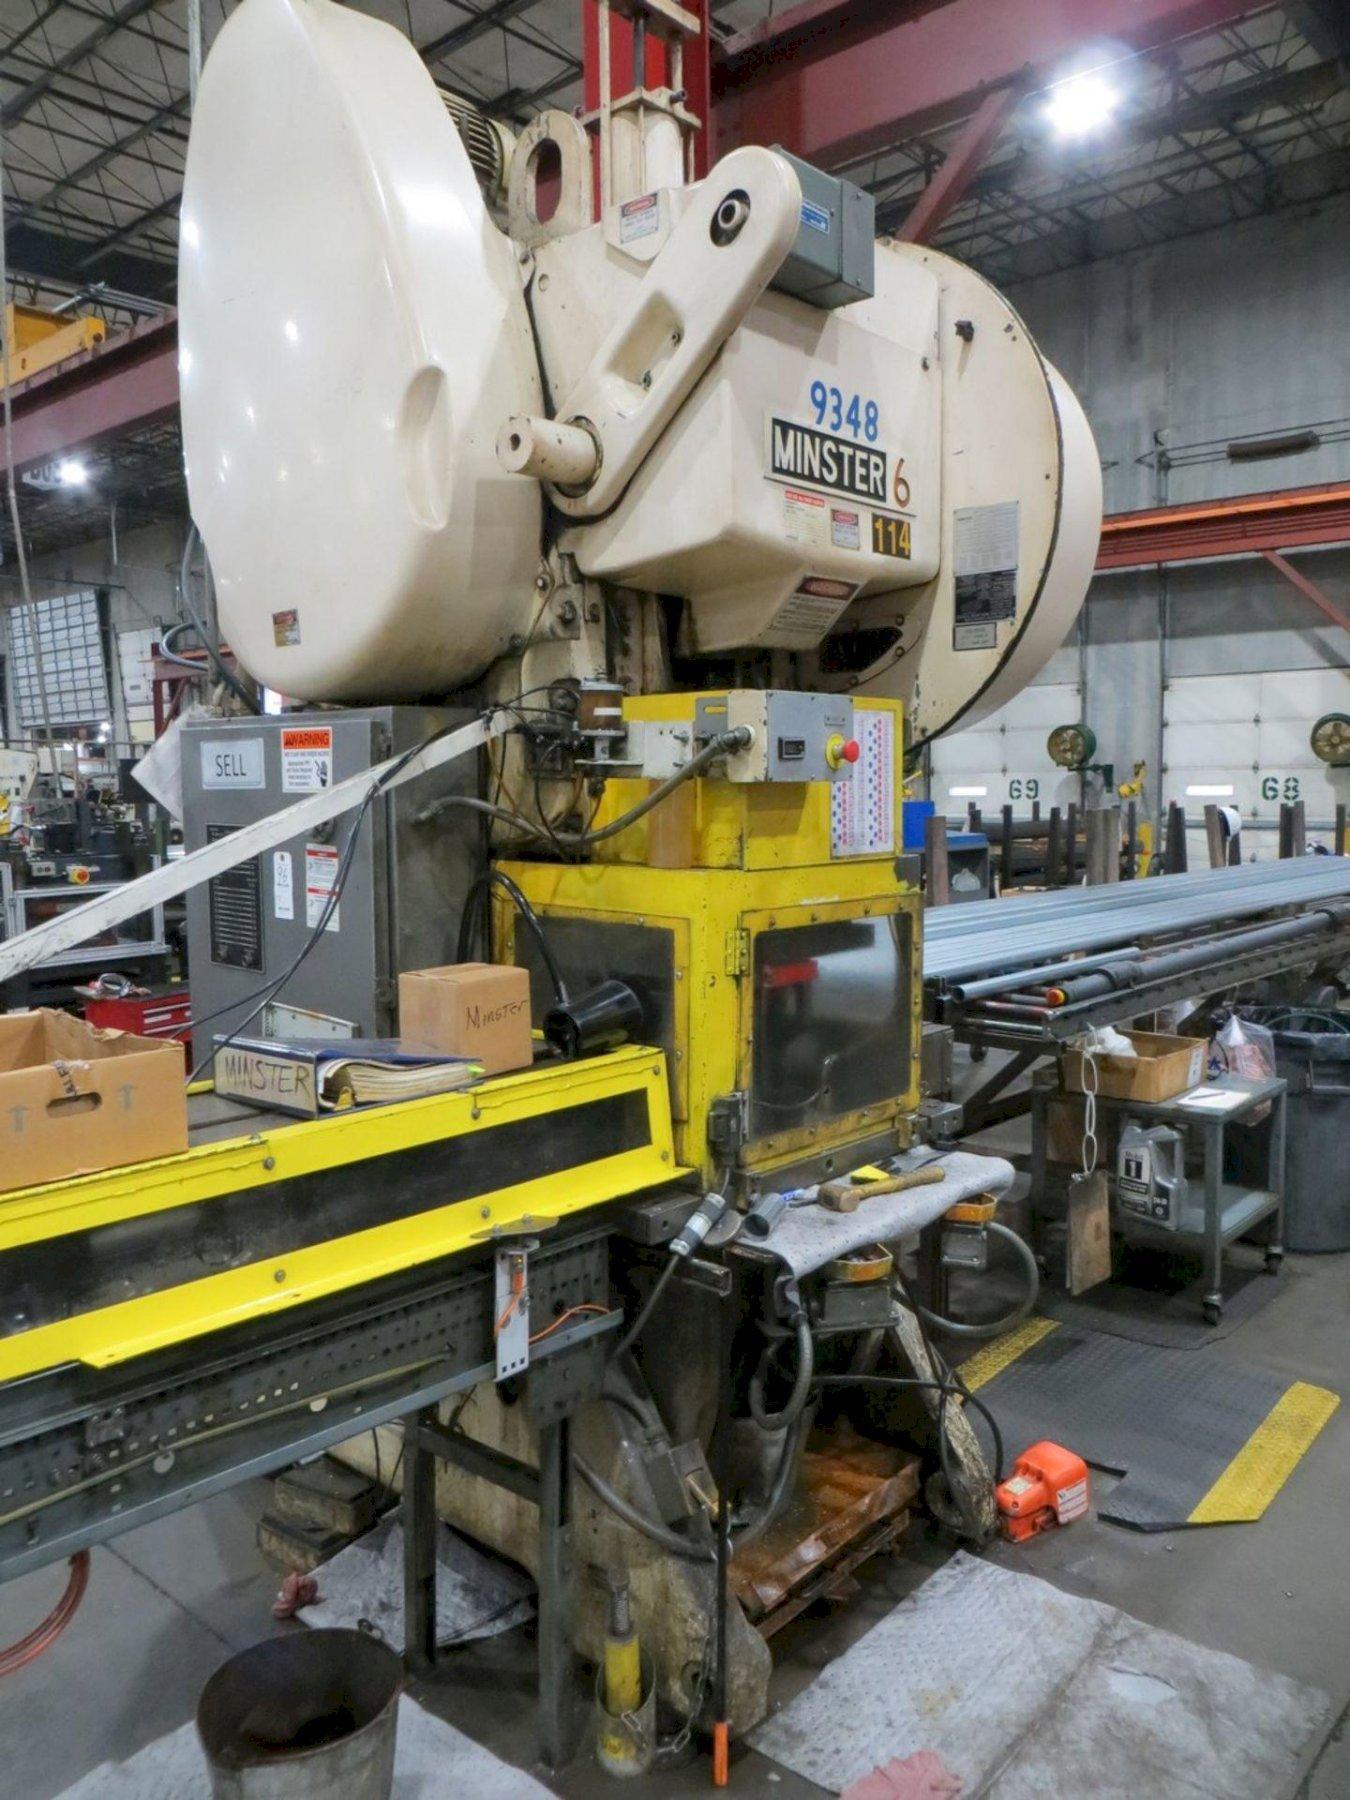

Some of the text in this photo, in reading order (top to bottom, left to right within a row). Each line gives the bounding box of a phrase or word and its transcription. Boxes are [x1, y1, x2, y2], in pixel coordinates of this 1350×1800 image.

[810, 380, 878, 442] 9348
[774, 424, 910, 509] MINSTER 6
[875, 518, 911, 556] 114
[292, 732, 330, 747] WARNING
[215, 754, 247, 777] SELL
[1009, 779, 1039, 800] 69
[1262, 776, 1299, 800] 68
[225, 1055, 312, 1100] MINSTER
